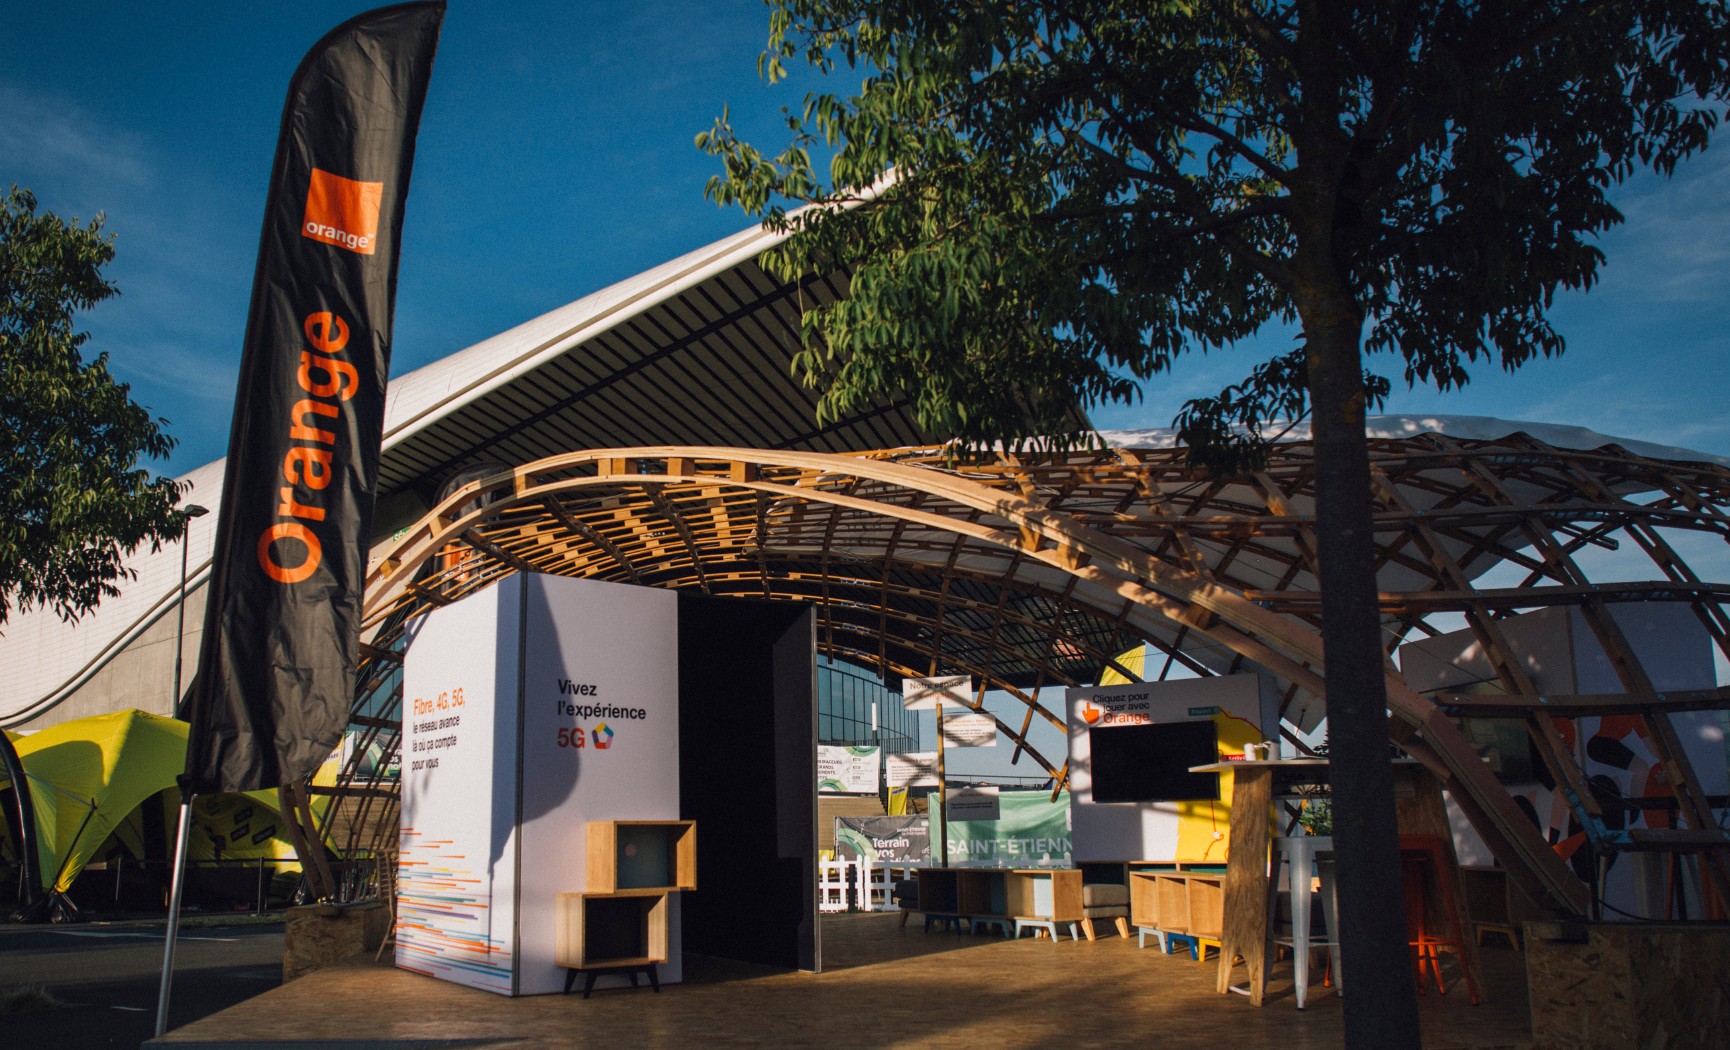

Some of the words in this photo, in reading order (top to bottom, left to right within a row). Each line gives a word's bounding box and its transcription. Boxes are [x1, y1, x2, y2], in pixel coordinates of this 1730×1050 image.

[256, 310, 360, 584] Orange
[557, 679, 597, 697] Vivez
[909, 681, 932, 690] Notre
[934, 680, 964, 690] espace
[413, 698, 435, 716] Fibre,
[436, 691, 450, 712] 4G,
[452, 687, 466, 708] 5G,
[1092, 694, 1126, 704] Cliquez
[1128, 692, 1149, 702] pour
[557, 700, 646, 720] l'expérience
[1103, 703, 1126, 713] jouer
[1128, 703, 1149, 711] avec
[412, 722, 418, 734] le
[419, 720, 438, 733] réseau
[439, 715, 460, 730] avance
[1103, 712, 1150, 724] Orange
[412, 739, 418, 752] là
[419, 738, 426, 751] où
[427, 739, 434, 754] ça
[434, 734, 457, 750] compte
[557, 727, 585, 749] 5G
[411, 759, 425, 773] pour
[425, 757, 439, 769] vous
[872, 836, 910, 848] Terrain
[875, 849, 895, 858] vos
